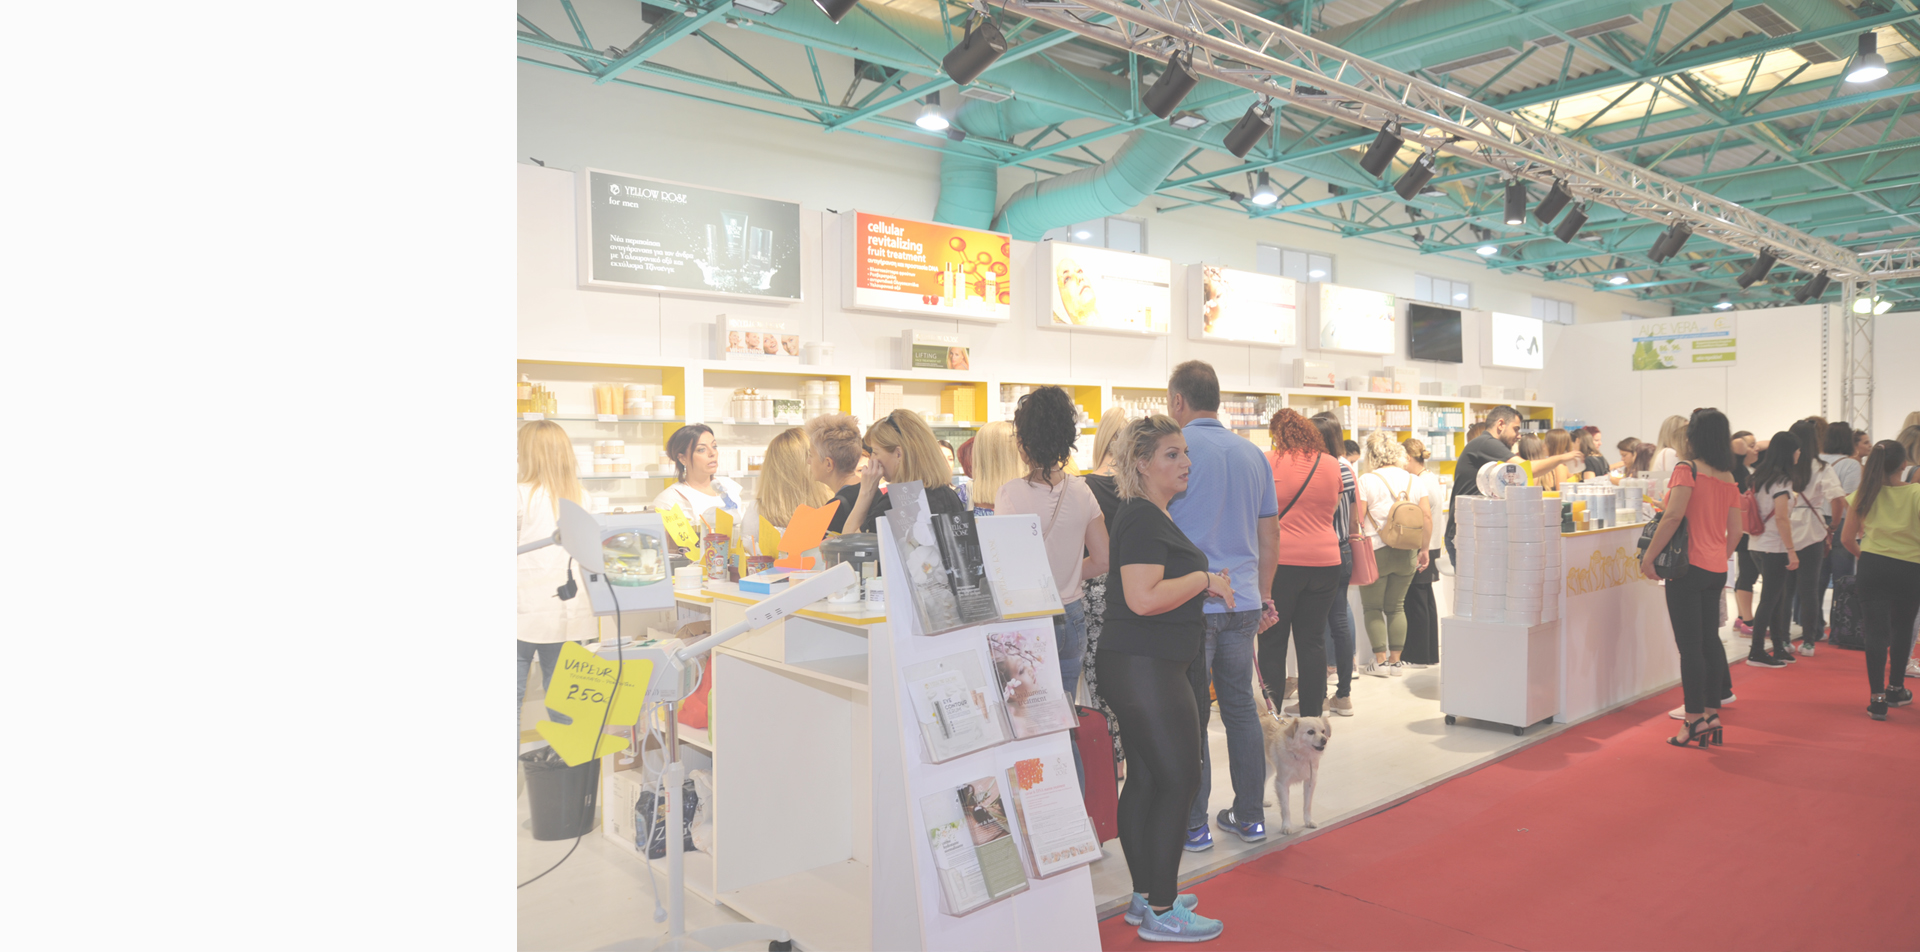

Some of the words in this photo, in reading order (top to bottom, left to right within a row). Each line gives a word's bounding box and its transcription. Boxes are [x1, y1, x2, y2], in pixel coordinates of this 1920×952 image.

[624, 185, 659, 199] YELLOW
[661, 190, 687, 204] ROSE
[608, 196, 620, 206] for
[622, 200, 639, 209] men
[868, 222, 904, 238] cellular
[610, 234, 624, 243] Νέα
[625, 238, 661, 248] περιποίηση
[868, 235, 923, 255] revitalizing
[868, 246, 886, 258] fruit
[887, 249, 926, 263] treatment
[1639, 322, 1667, 336] ALOE
[1670, 320, 1699, 334] VERA
[915, 352, 937, 360] LIFTING
[565, 659, 613, 677] VAPEUR
[1015, 687, 1048, 699] hyaluronic
[942, 697, 953, 705] EYE
[944, 699, 968, 710] CONTOUR
[1017, 695, 1047, 707] treatment
[946, 707, 962, 716] SERUM
